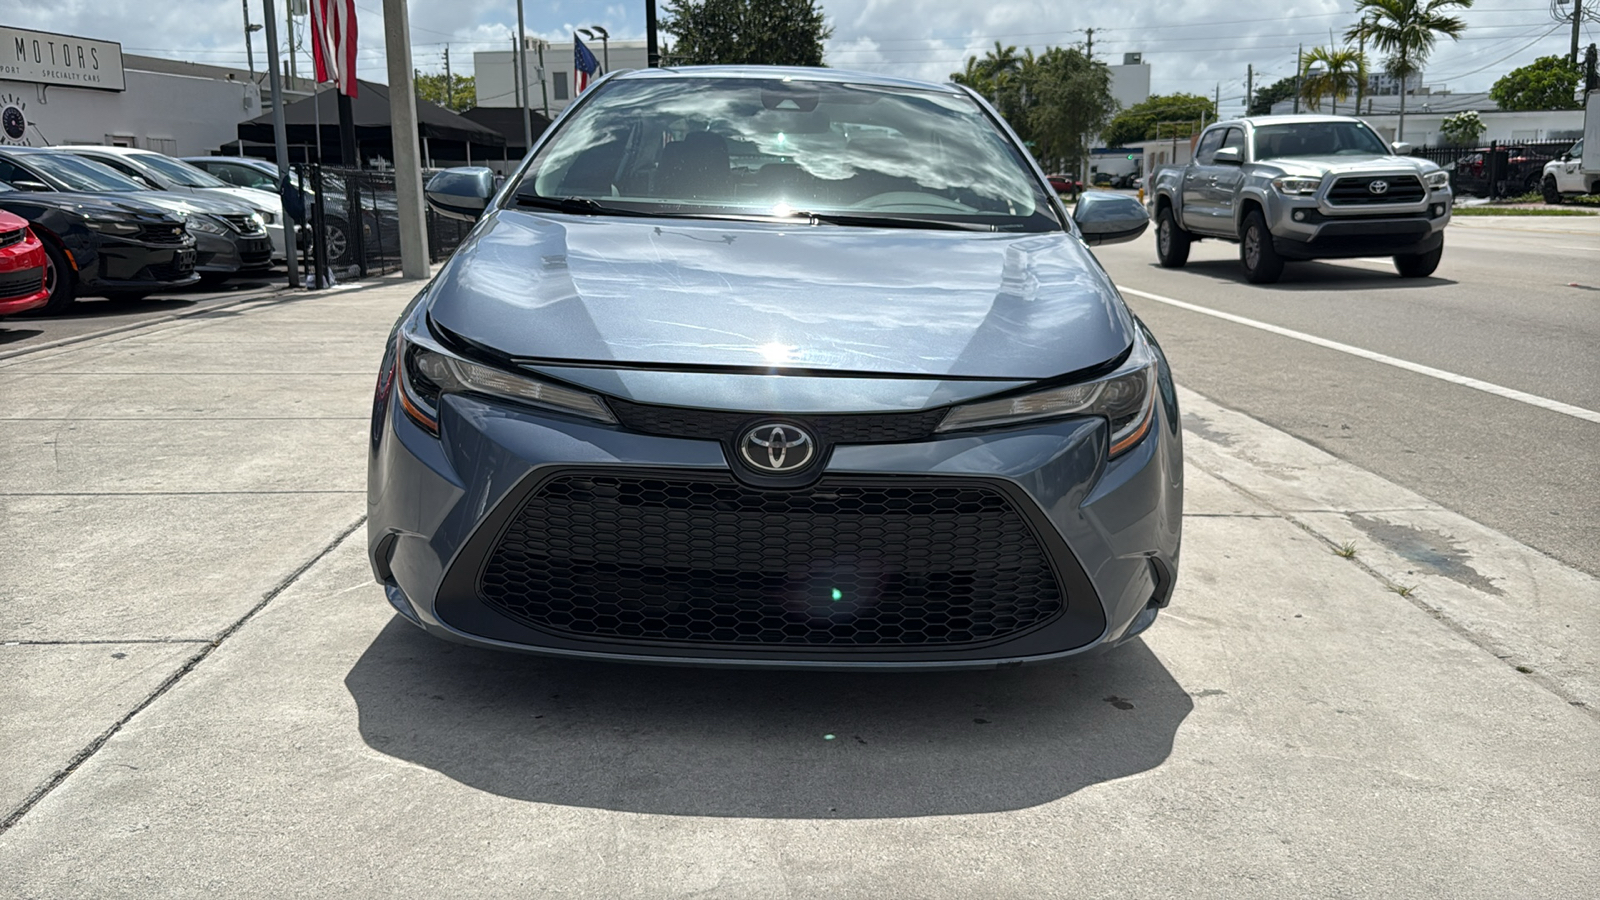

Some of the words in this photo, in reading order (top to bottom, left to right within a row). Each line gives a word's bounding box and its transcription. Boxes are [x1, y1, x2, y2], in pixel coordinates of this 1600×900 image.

[14, 36, 100, 71] MOTORS
[42, 69, 80, 81] SPECIALTY
[83, 73, 100, 83] CARS
